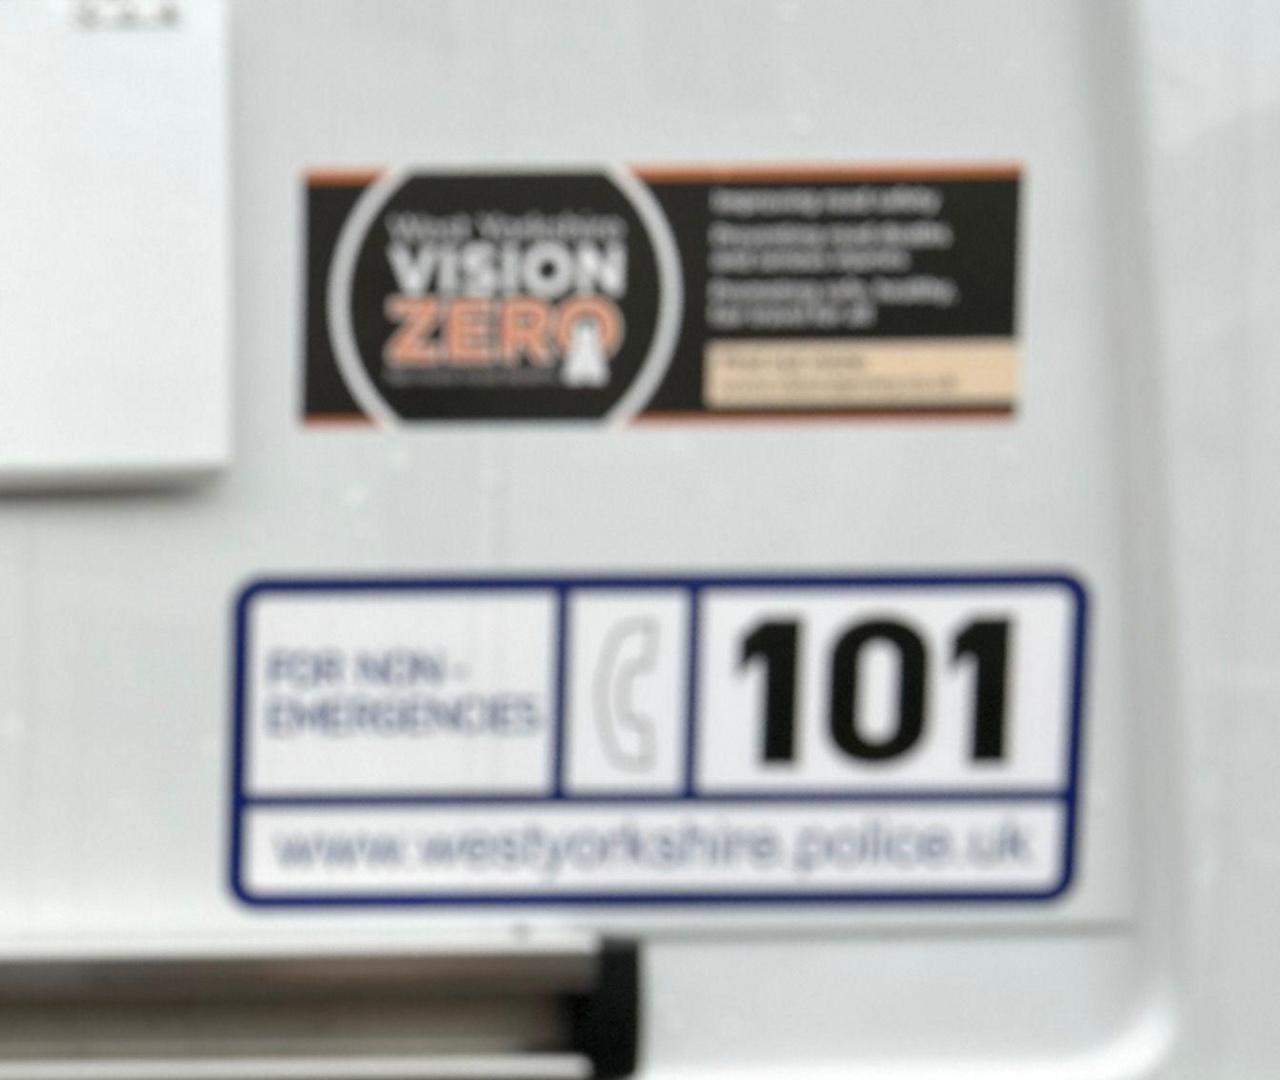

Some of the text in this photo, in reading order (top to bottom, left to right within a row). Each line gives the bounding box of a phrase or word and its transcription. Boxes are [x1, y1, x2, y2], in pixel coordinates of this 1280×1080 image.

[388, 240, 627, 297] VISION
[384, 296, 624, 368] ZERO
[265, 647, 344, 685] FOR
[736, 612, 1013, 766] 101
[264, 692, 539, 738] EMERGENCIES
